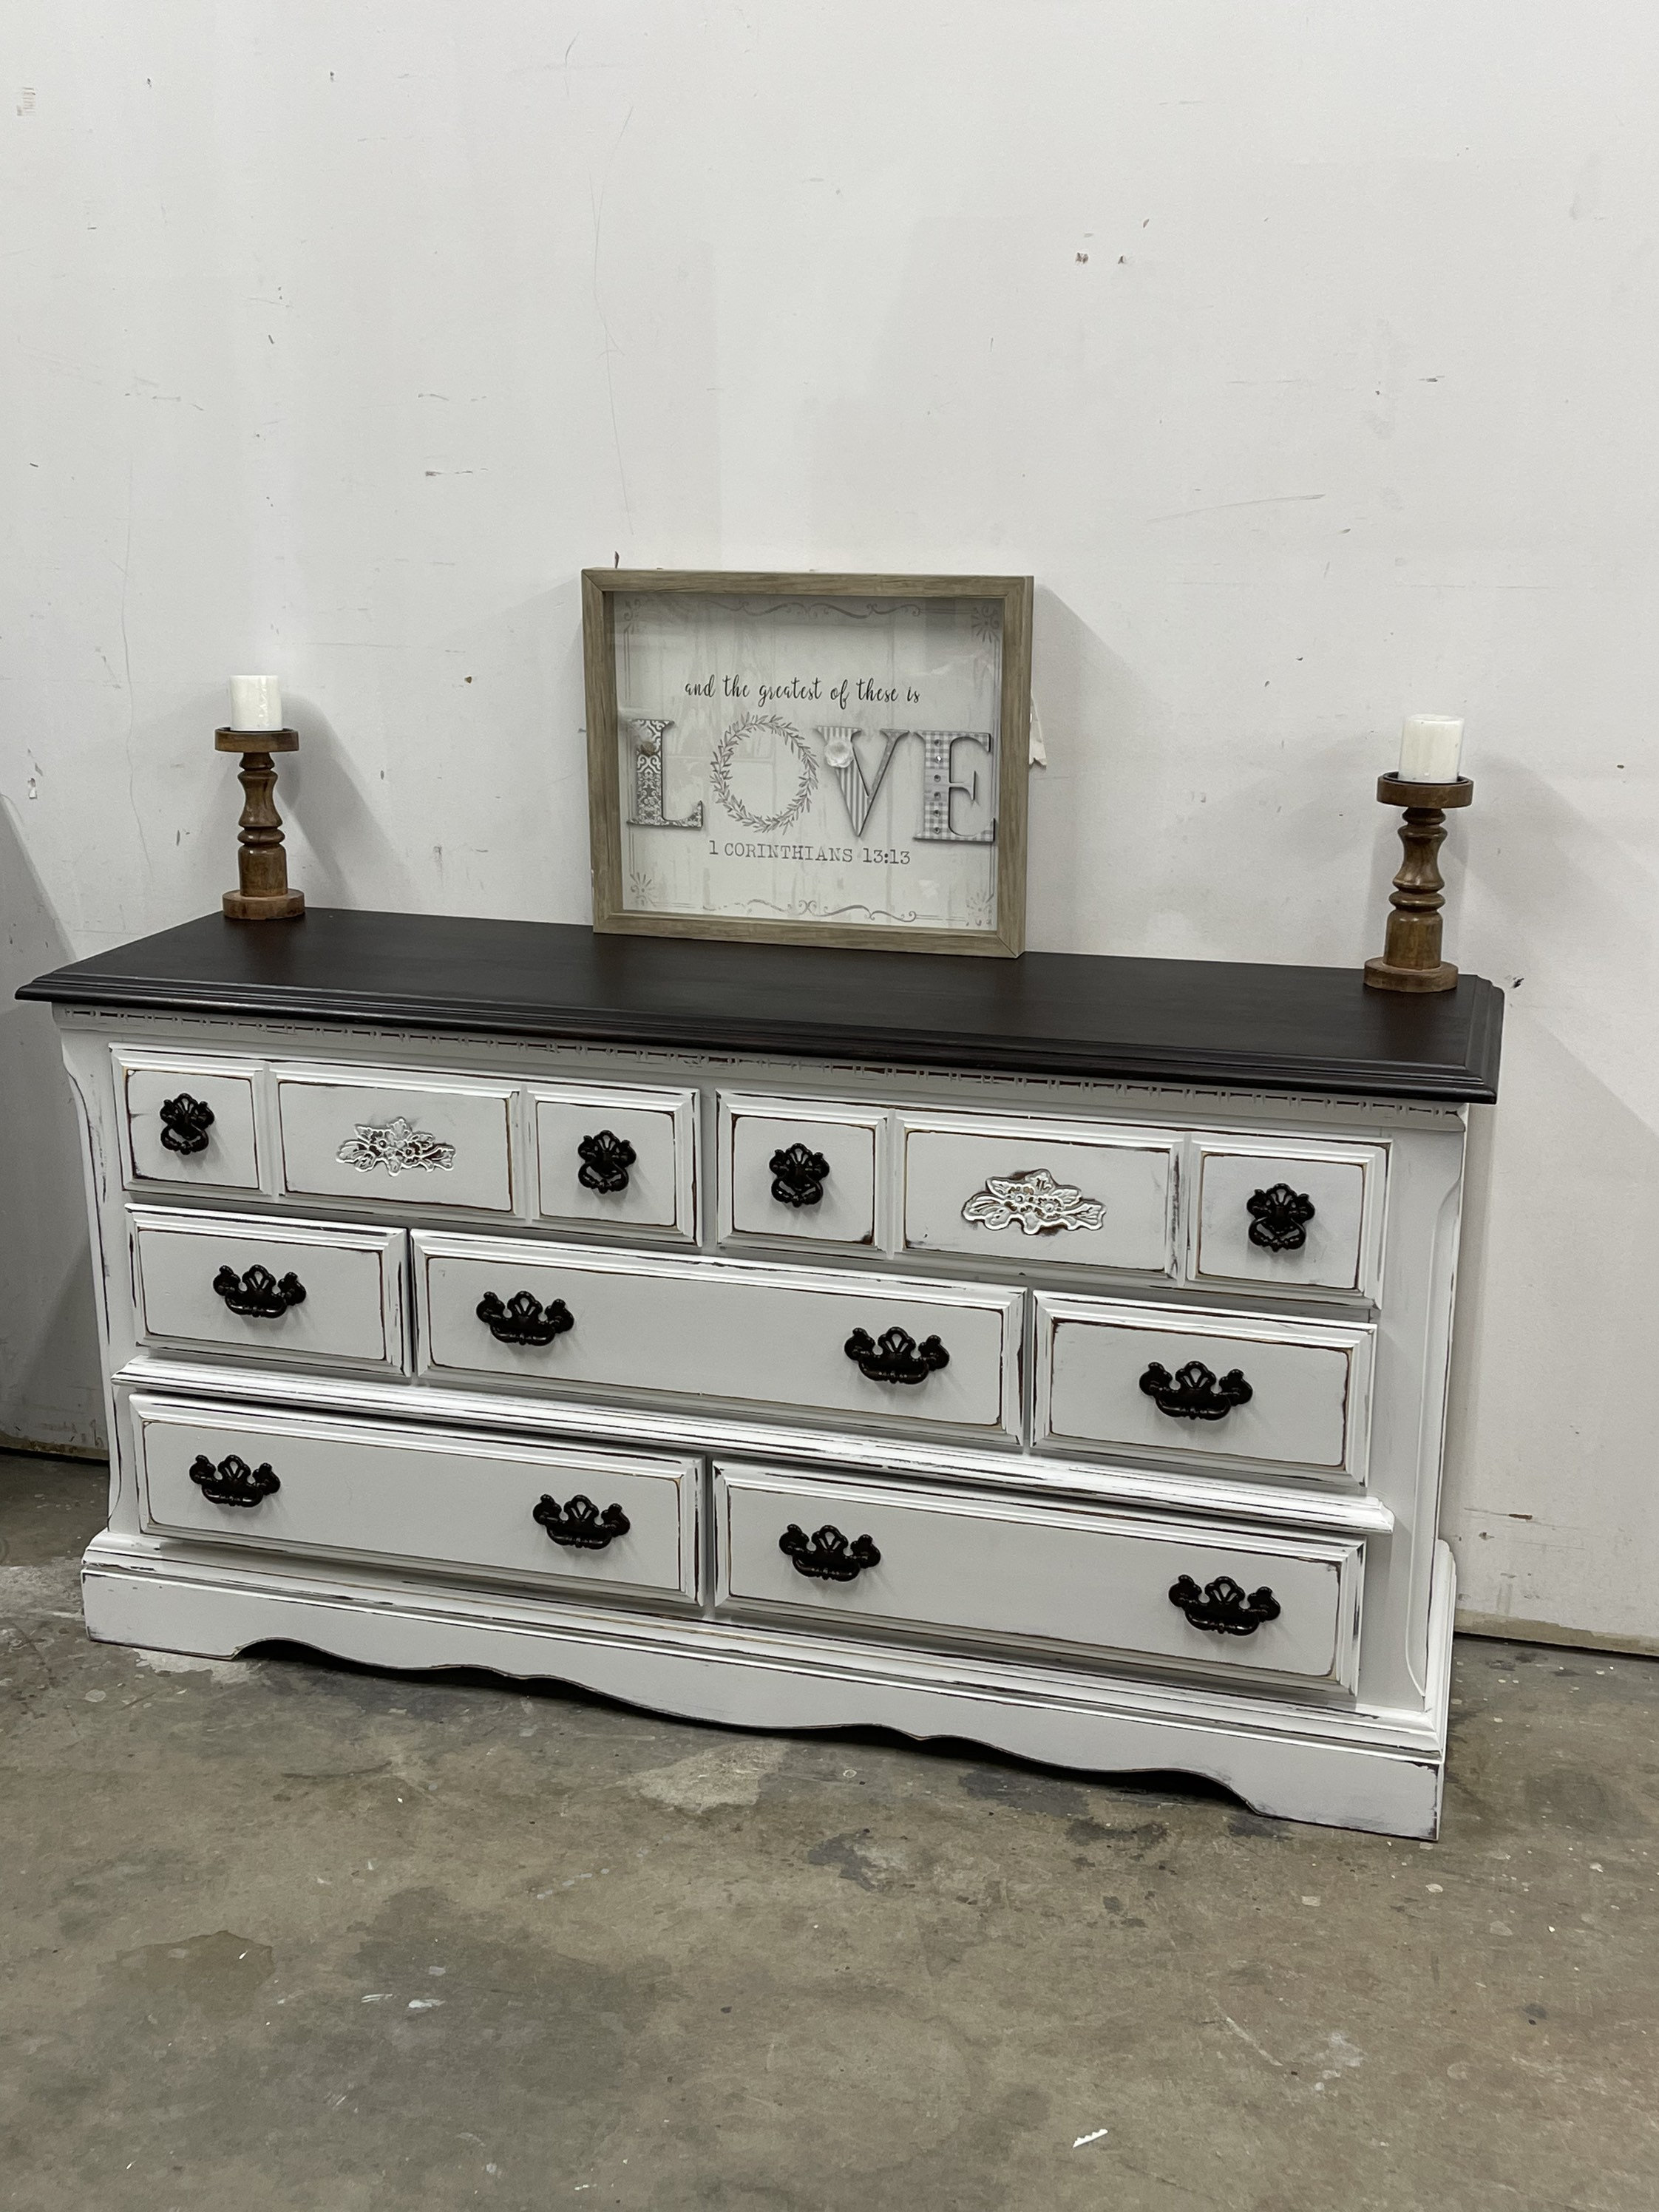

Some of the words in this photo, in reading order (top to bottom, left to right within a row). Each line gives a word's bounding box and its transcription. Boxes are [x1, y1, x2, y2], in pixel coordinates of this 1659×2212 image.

[685, 674, 716, 698] and
[722, 674, 750, 699] the
[759, 676, 822, 707] greatest
[830, 679, 849, 710] of
[855, 677, 899, 702] these
[906, 686, 920, 703] is
[626, 711, 995, 842] LOVE
[709, 841, 719, 855] 1
[725, 843, 852, 863] CORINTHIANS
[862, 848, 911, 864] 13:13
